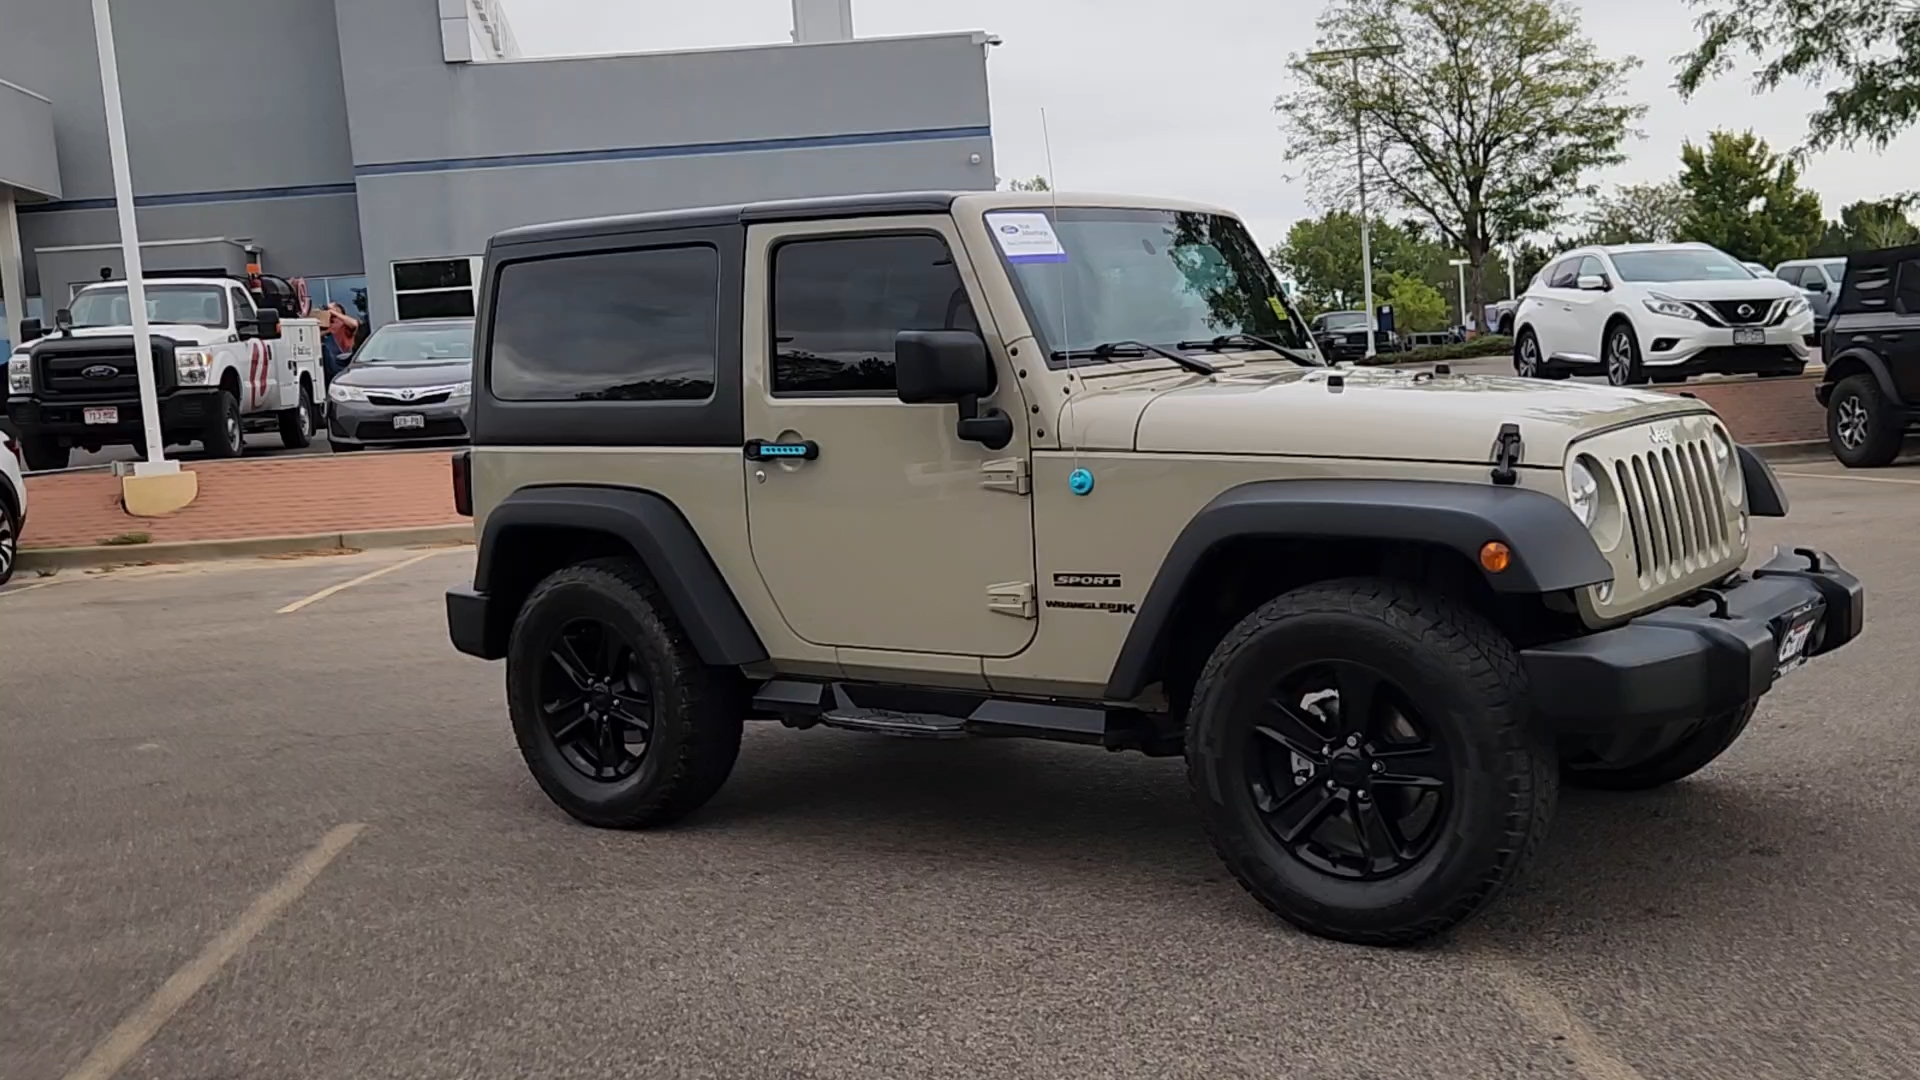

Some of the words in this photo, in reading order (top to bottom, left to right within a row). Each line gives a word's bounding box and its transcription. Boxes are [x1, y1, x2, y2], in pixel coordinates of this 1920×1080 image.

[1648, 425, 1672, 444] Jeep
[1054, 575, 1120, 586] SPORT
[1045, 600, 1117, 610] WRANGLER
